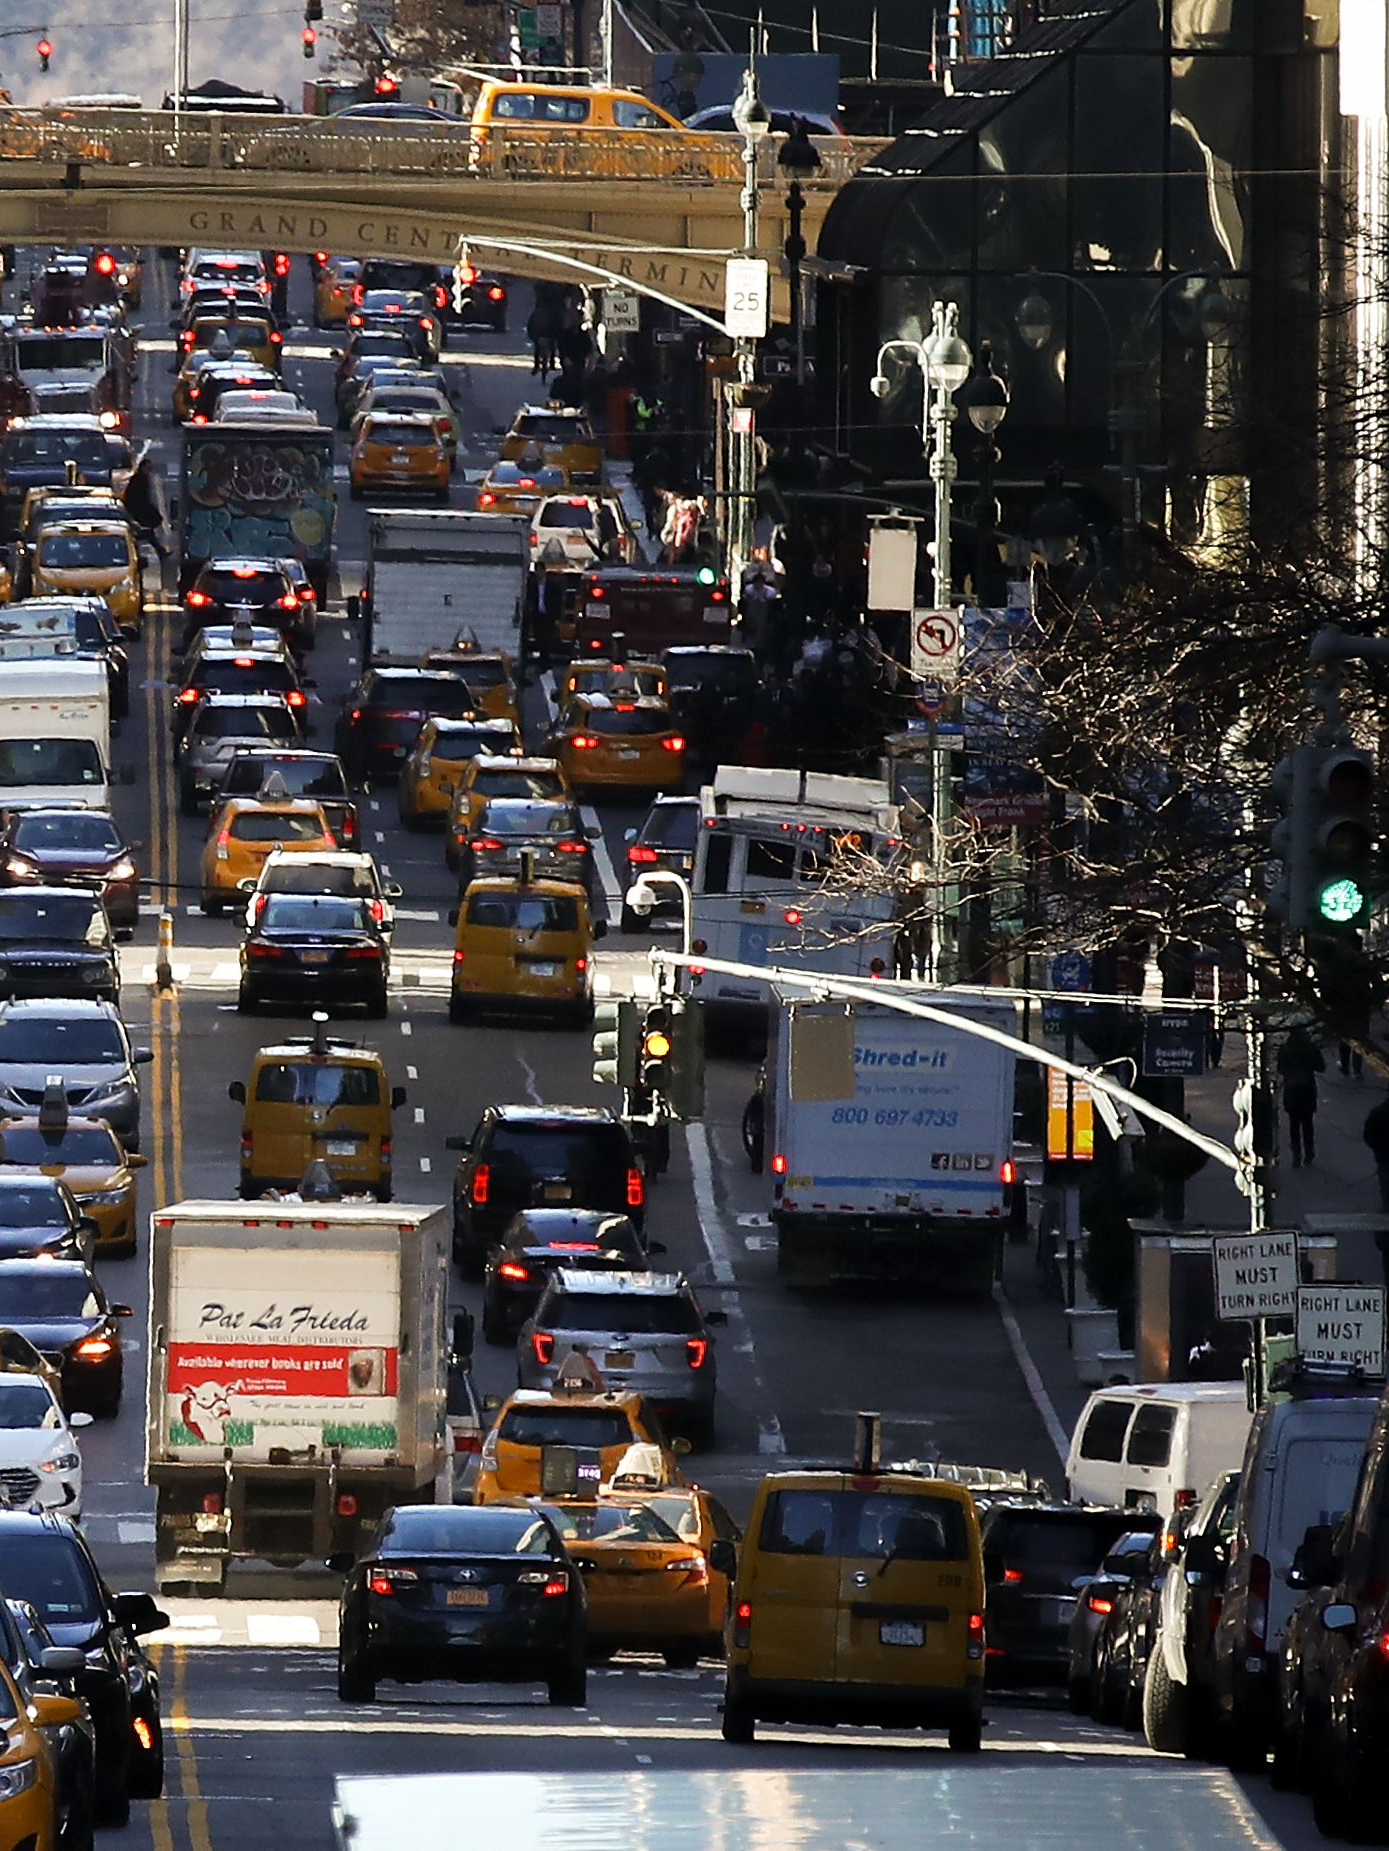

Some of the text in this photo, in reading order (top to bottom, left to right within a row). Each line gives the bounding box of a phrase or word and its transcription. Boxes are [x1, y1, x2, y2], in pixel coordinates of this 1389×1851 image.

[189, 211, 328, 238] GRAND
[613, 302, 629, 314] NO
[733, 292, 759, 311] 25
[606, 316, 638, 327] TURNS
[855, 1047, 948, 1068] Shred-it
[1156, 1058, 1193, 1067] Camera
[832, 1107, 959, 1127] 800 697 4733
[1218, 1242, 1293, 1261] RIGHT LANE
[1235, 1266, 1279, 1285] MUST
[1221, 1291, 1296, 1309] TURN RIGHT
[1301, 1297, 1381, 1312] RIGHT LANE
[199, 1303, 245, 1329] Pat
[205, 1334, 263, 1343] WHOLESALE
[267, 1335, 292, 1343] MEAT
[1317, 1322, 1363, 1340] MUST
[177, 1356, 344, 1371] Available wherever books are sold
